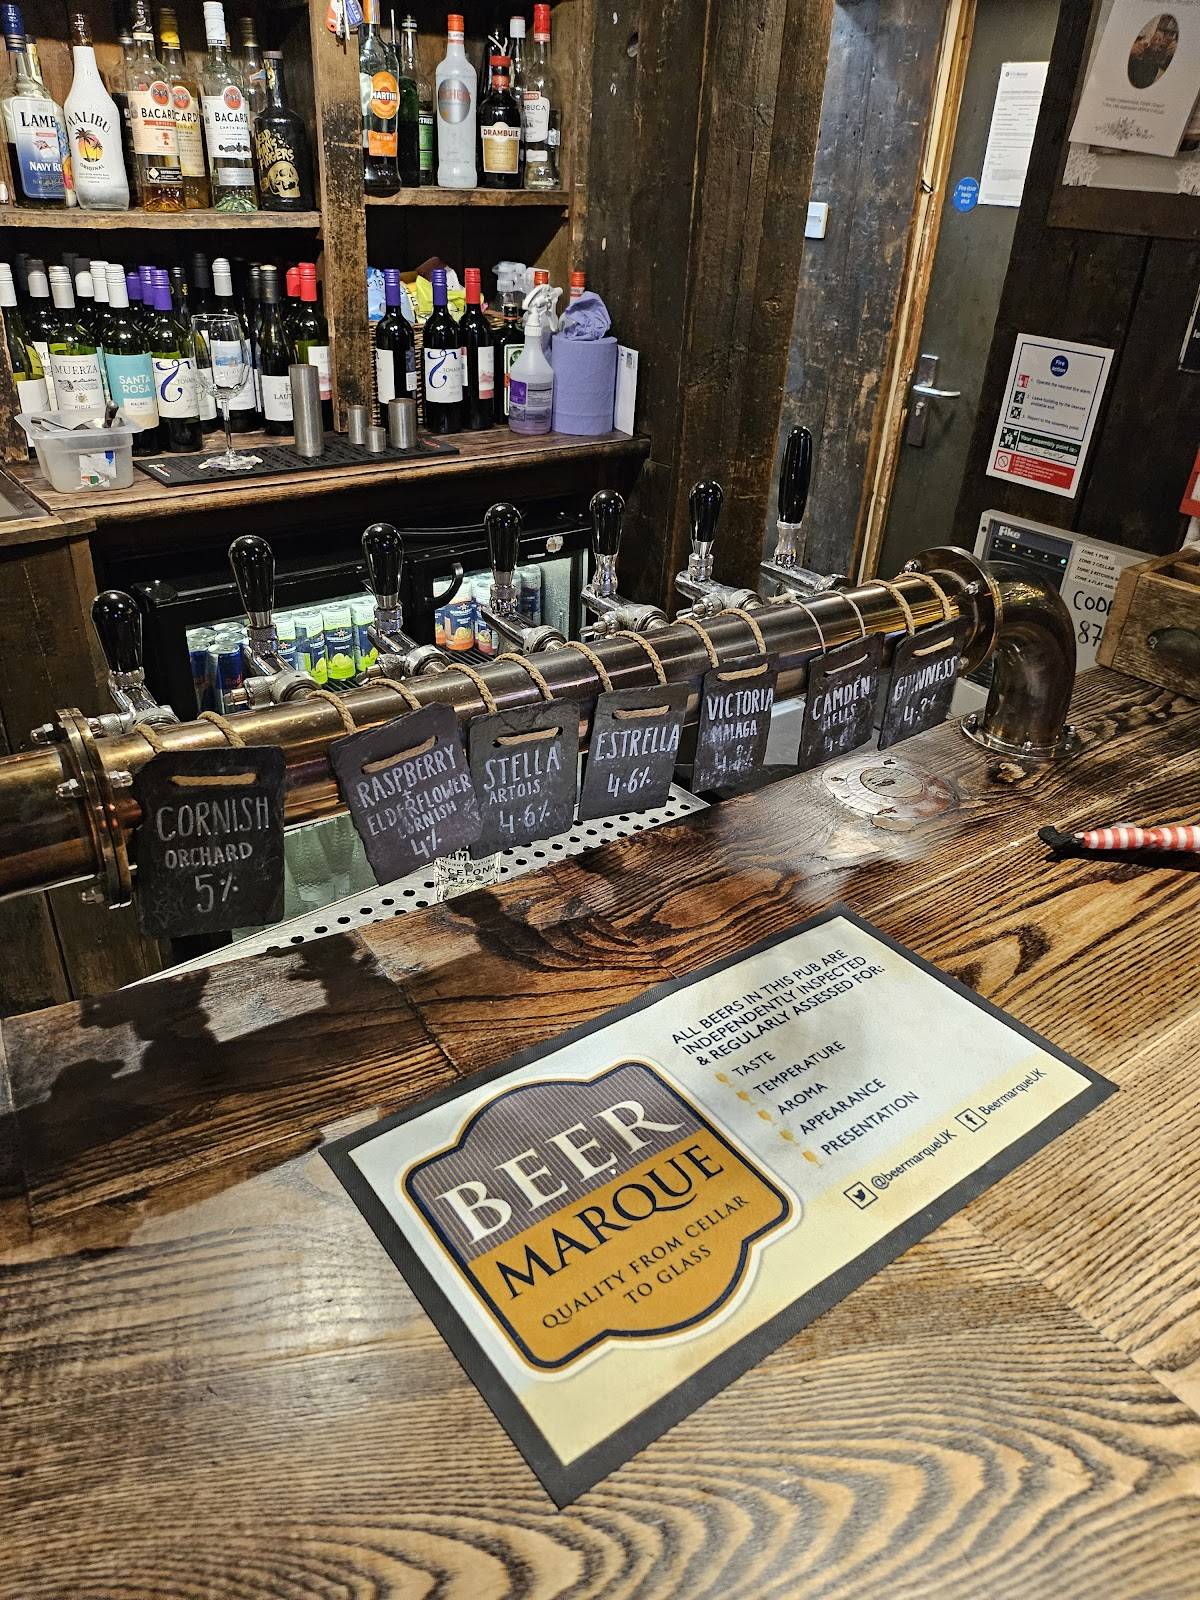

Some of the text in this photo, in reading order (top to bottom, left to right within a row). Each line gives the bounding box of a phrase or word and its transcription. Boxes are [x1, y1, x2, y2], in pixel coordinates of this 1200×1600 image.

[67, 111, 112, 134] MALIBU
[483, 128, 519, 138] DRAMBUIE
[29, 161, 51, 171] NAVY
[119, 374, 151, 385] SANTA
[122, 384, 151, 394] ROSA
[999, 525, 1021, 539] Fike
[812, 675, 871, 721] CAMDEN
[893, 656, 958, 702] GUINNESS
[706, 687, 774, 721] VICTORIA
[594, 724, 680, 762] ESTRELLA
[709, 720, 758, 743] MALAGA
[356, 744, 457, 809] RASPBERRY
[483, 745, 560, 791] STELLA
[367, 773, 472, 837] ELDERFLOWER
[489, 779, 541, 805] ARTOIS
[156, 796, 269, 841] CORNISH
[164, 842, 253, 869] ORCHARD
[410, 828, 442, 858] 4%
[194, 872, 239, 913] 5%
[671, 949, 849, 1045] ALL BEERS IN THIS PUB ARE
[681, 955, 868, 1056] INDEPENDENTLY INSPECTED
[695, 964, 886, 1067] & REGULARLY ASSESSED FOR:
[731, 1050, 777, 1078] TASTE
[752, 1040, 847, 1096] TEMPERATURE
[777, 1082, 829, 1116] AROMA
[799, 1077, 887, 1136] APPEARANCE
[820, 1090, 920, 1157] PRESENTATION
[870, 1067, 1048, 1191] @beermarqueUK BeermarqueUK
[434, 1098, 688, 1245] BEER
[494, 1143, 726, 1301] MARQUE
[541, 1194, 751, 1329] QUALITY FROM CELLAR
[622, 1243, 713, 1305] TO GLASS
